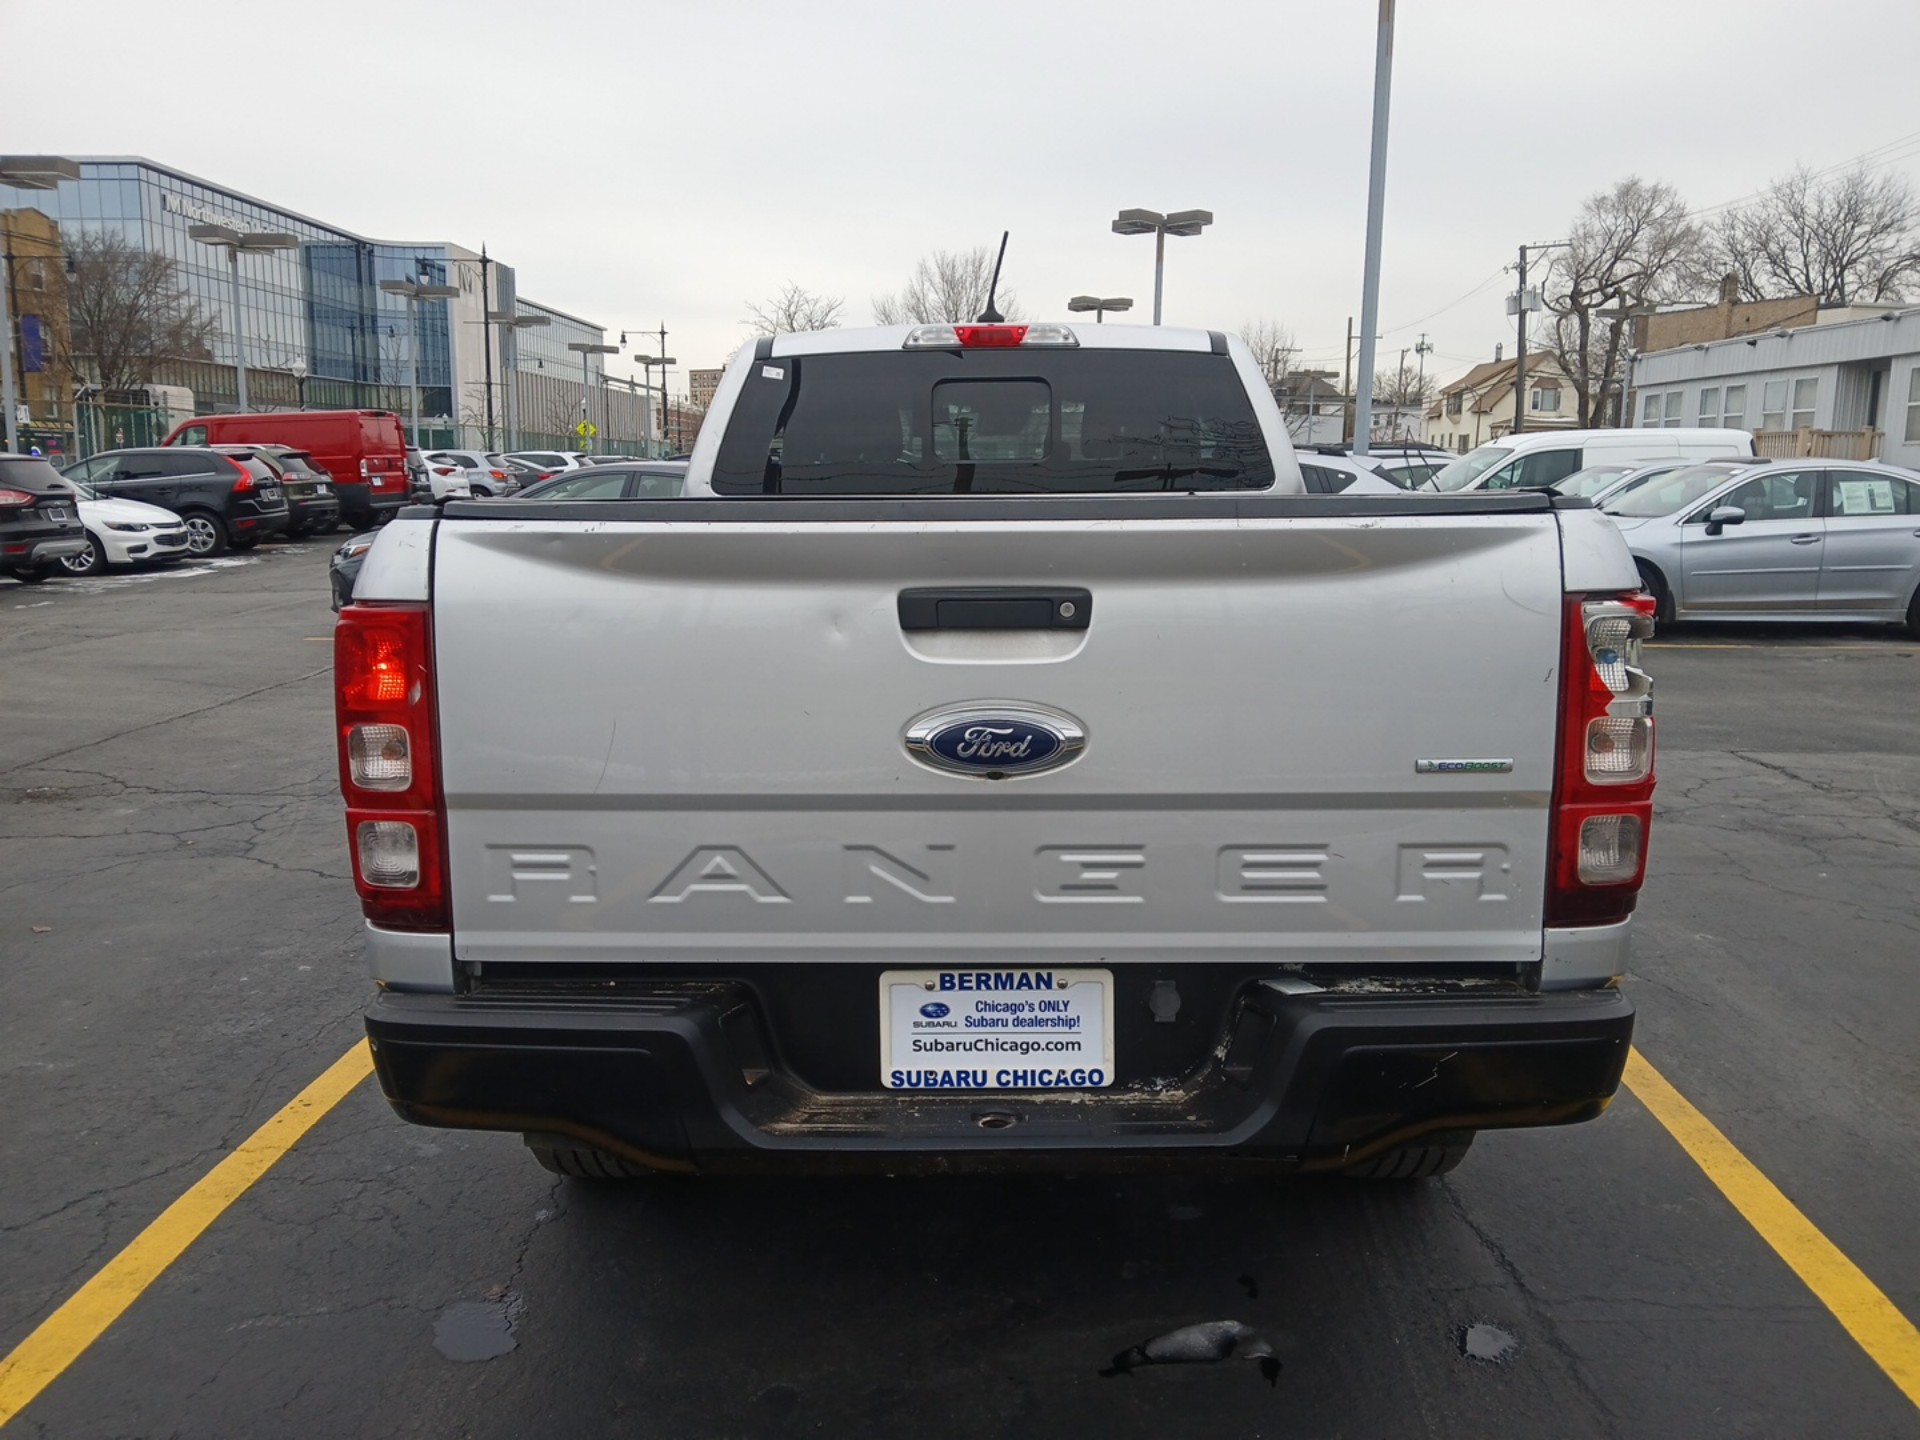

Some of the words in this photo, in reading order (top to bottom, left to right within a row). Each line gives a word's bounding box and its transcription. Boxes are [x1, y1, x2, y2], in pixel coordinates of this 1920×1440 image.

[956, 726, 1033, 758] Ford
[484, 843, 1511, 905] RANGER
[939, 971, 1053, 991] BERMAN
[975, 1000, 1036, 1015] Chicago's
[1038, 1000, 1070, 1013] ONLY
[912, 1020, 957, 1029] SUBARU
[964, 1015, 1009, 1028] Subaru
[1012, 1015, 1080, 1030] dealership!
[912, 1039, 1082, 1055] SubaruChicago.com
[890, 1070, 988, 1088] SUBARU
[995, 1068, 1105, 1087] CHICAGO
